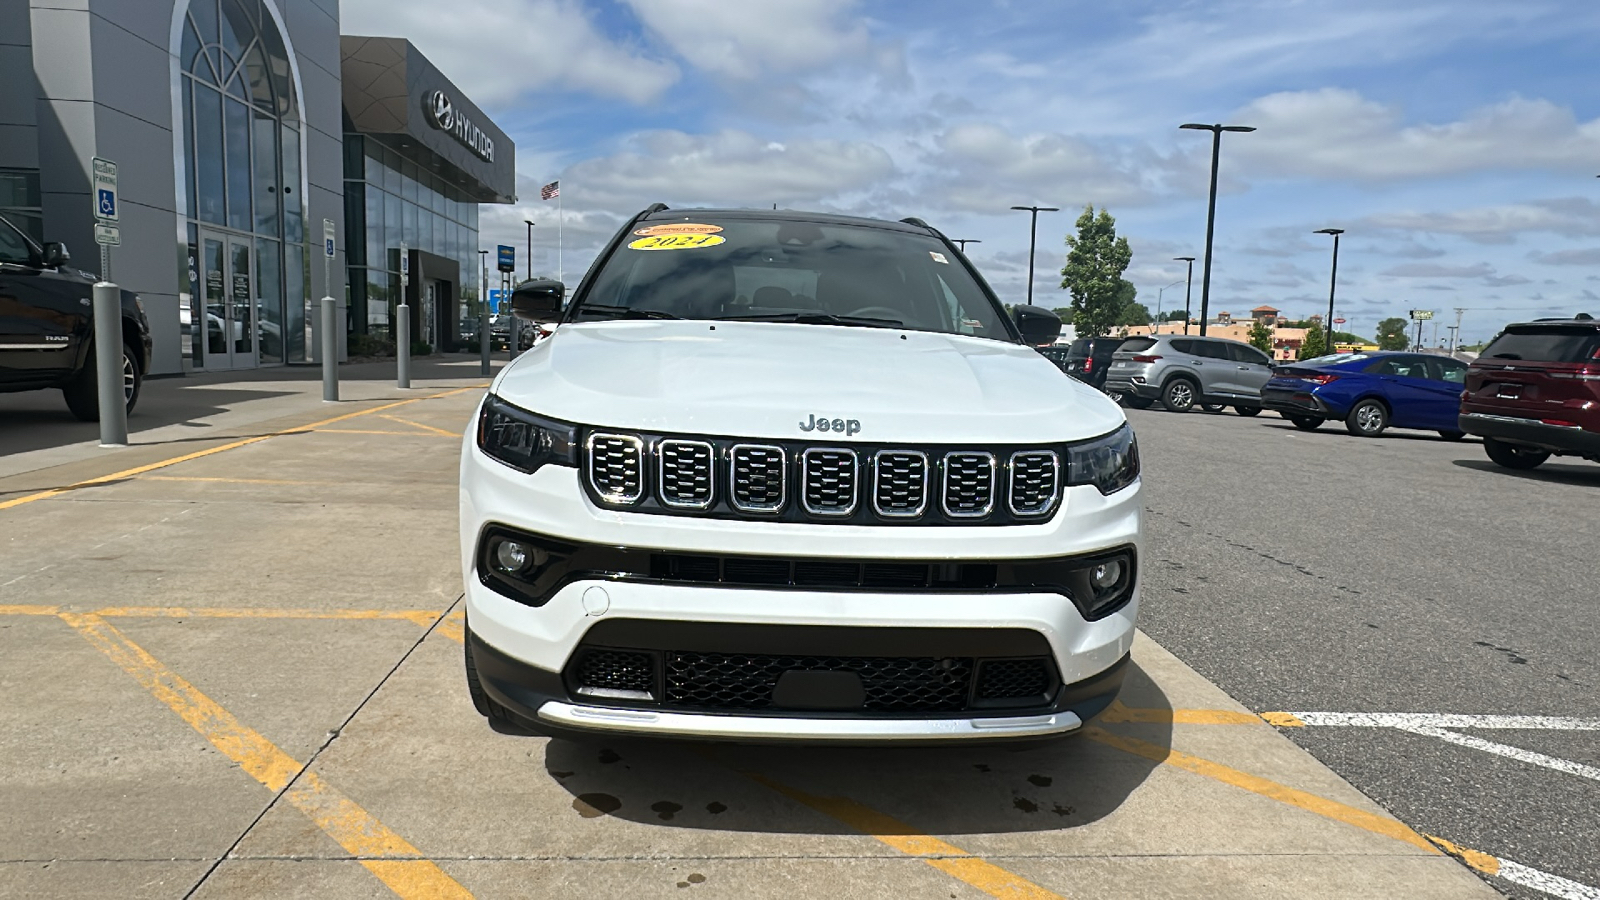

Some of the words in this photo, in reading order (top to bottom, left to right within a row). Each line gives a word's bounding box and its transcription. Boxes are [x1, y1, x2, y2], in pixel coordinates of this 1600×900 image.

[456, 109, 495, 163] HYUNDAI
[94, 162, 116, 176] RESERVED
[95, 173, 117, 186] PARKING
[641, 236, 713, 248] 2024
[799, 413, 861, 437] Jeep
